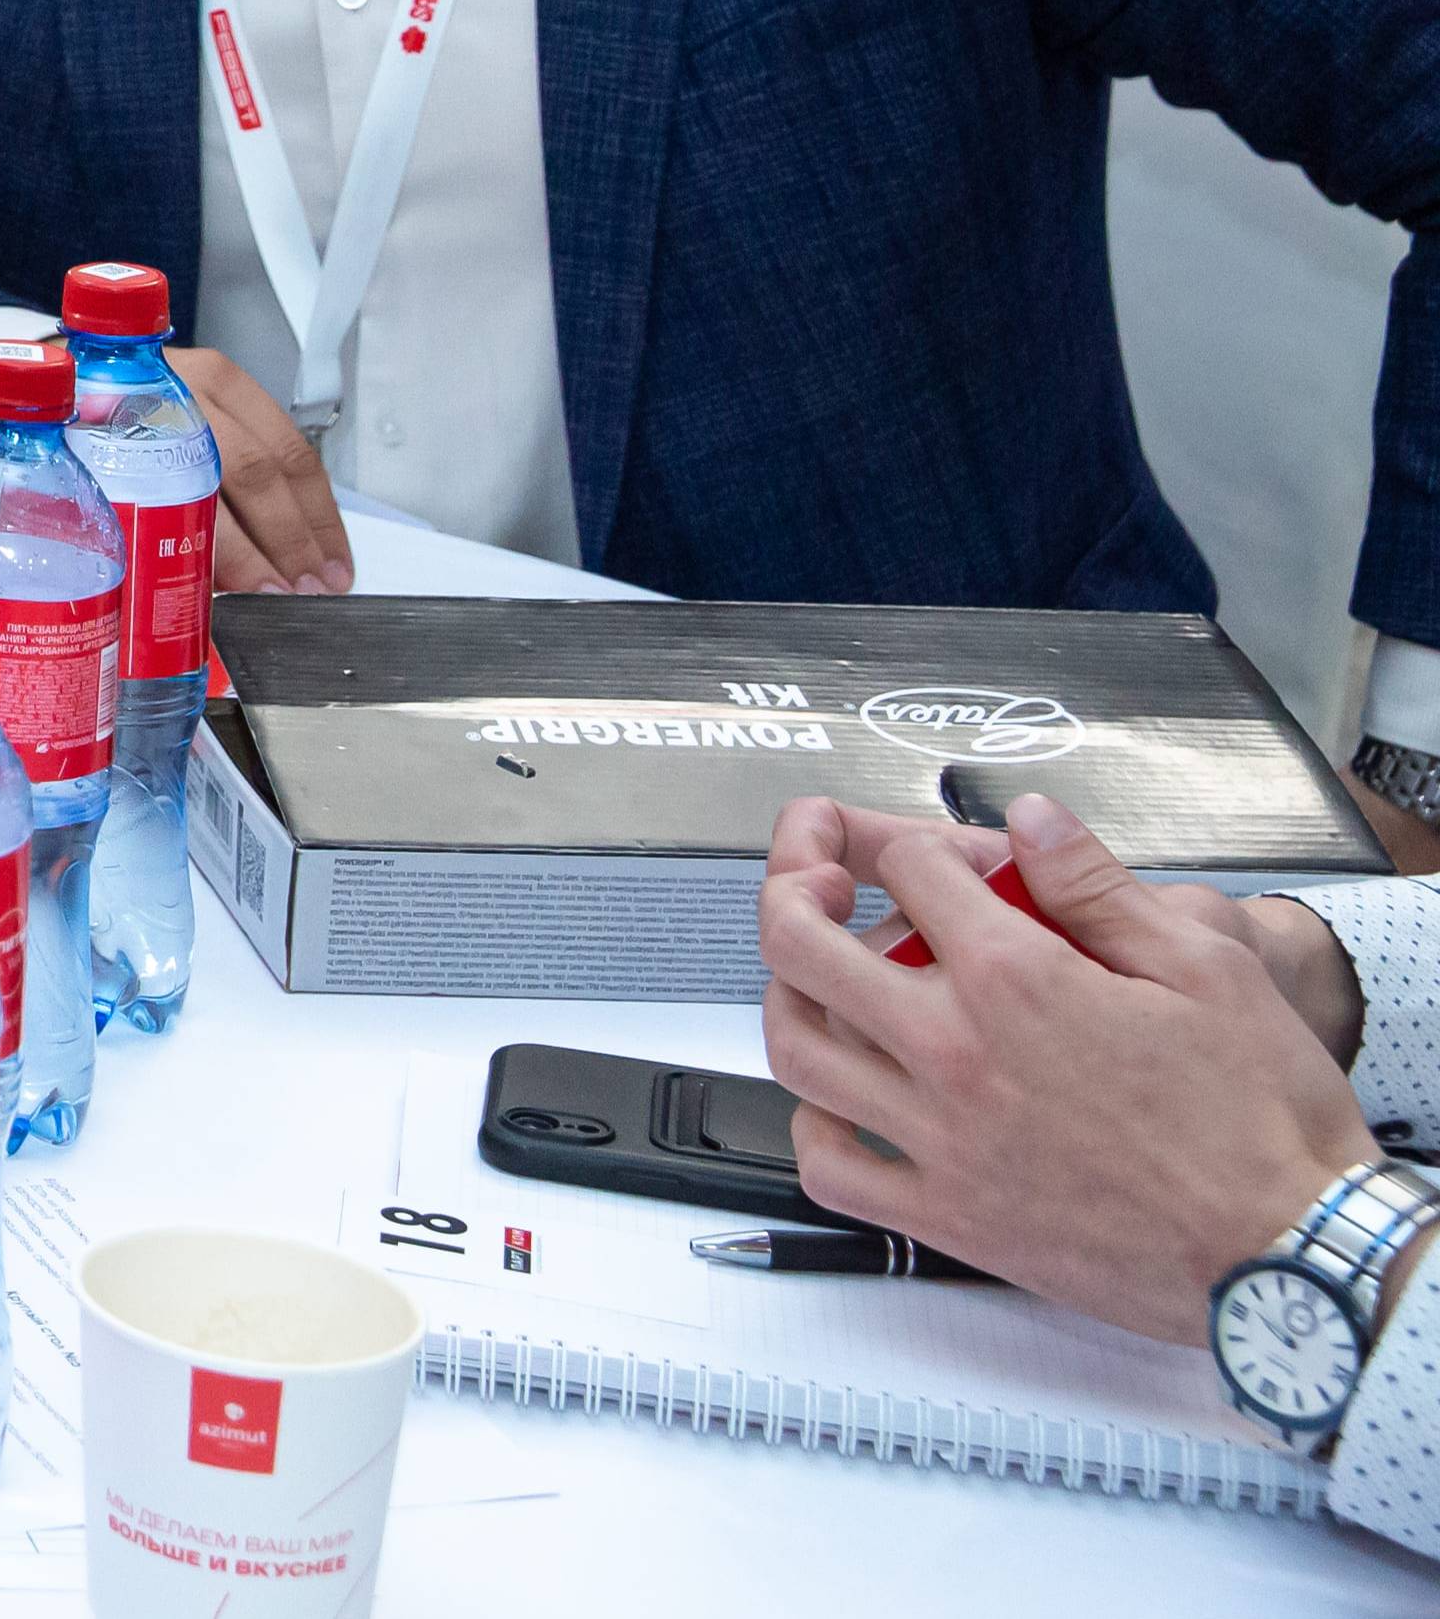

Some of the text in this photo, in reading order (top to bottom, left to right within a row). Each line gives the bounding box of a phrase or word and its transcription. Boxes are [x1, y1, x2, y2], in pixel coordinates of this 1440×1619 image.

[722, 682, 810, 708] Kit
[878, 693, 1073, 756] Gates
[379, 1206, 469, 1255] 18
[197, 1421, 268, 1445] azimut
[108, 1513, 347, 1579] БОЛЬШЕ И ВКУСНЕЕ
[137, 1507, 238, 1550] ДЕЛАЕМ
[245, 1535, 304, 1555] ВАШ
[307, 1529, 356, 1553] МИР
